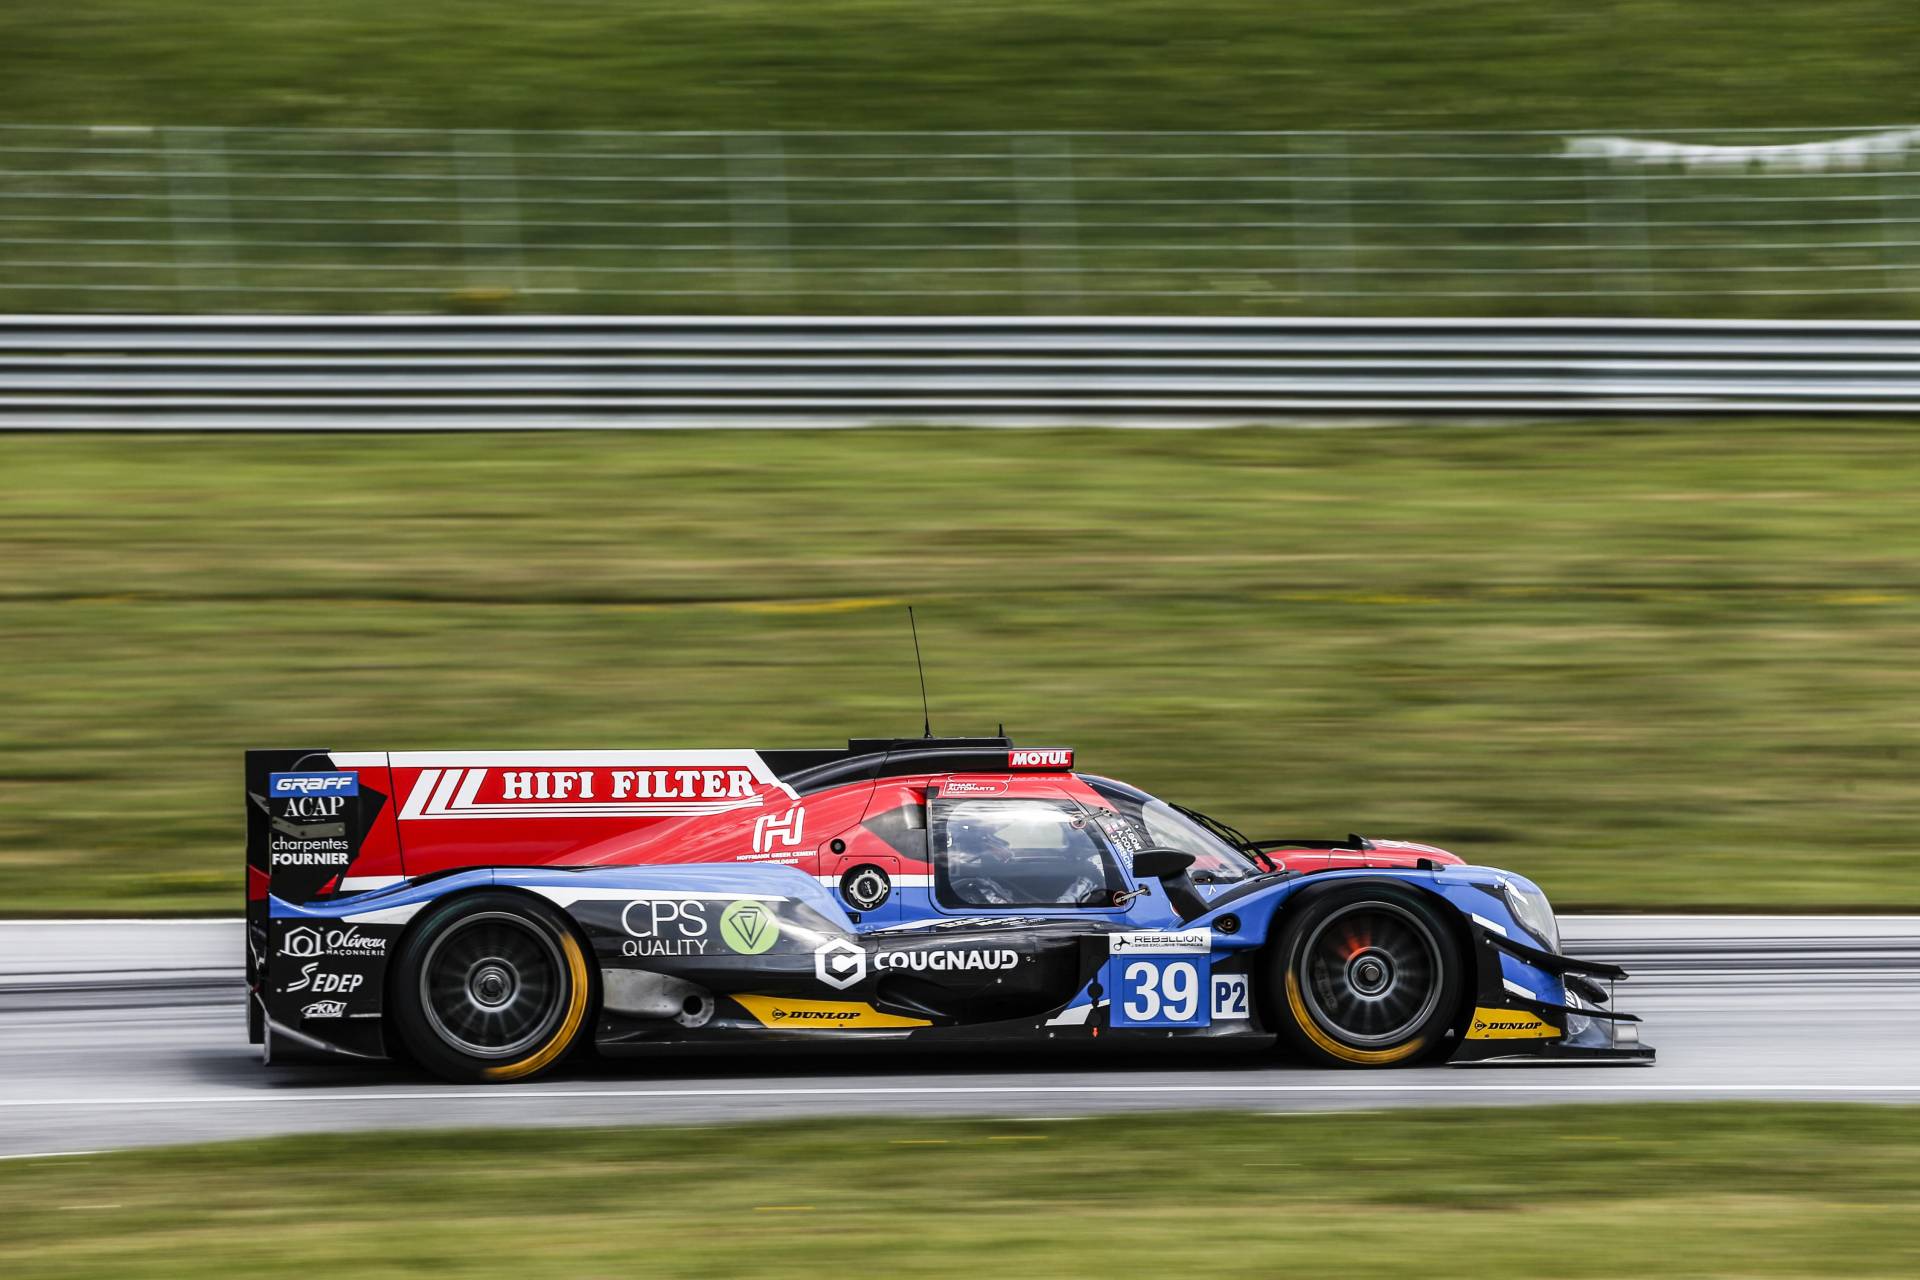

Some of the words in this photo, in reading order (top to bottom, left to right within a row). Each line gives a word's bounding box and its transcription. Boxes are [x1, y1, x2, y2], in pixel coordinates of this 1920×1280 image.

[1011, 752, 1068, 765] MOTUL
[502, 771, 595, 799] HIFI
[611, 769, 757, 798] FILTER
[284, 796, 345, 817] ACAP
[271, 836, 349, 852] charpentes
[1116, 830, 1134, 858] A.COUG
[1125, 827, 1142, 851] T.GOM
[271, 853, 349, 865] FOURNIER
[621, 900, 708, 938] CPS
[622, 939, 709, 957] QUALITY
[1134, 935, 1204, 943] REBELLION
[874, 950, 1019, 971] COUGNAUD
[286, 962, 364, 993] SEDEP
[1123, 961, 1199, 1021] 39
[1215, 981, 1246, 1013] P2
[789, 1011, 861, 1020] DUNLOP
[1488, 1021, 1542, 1030] DUNLOP
